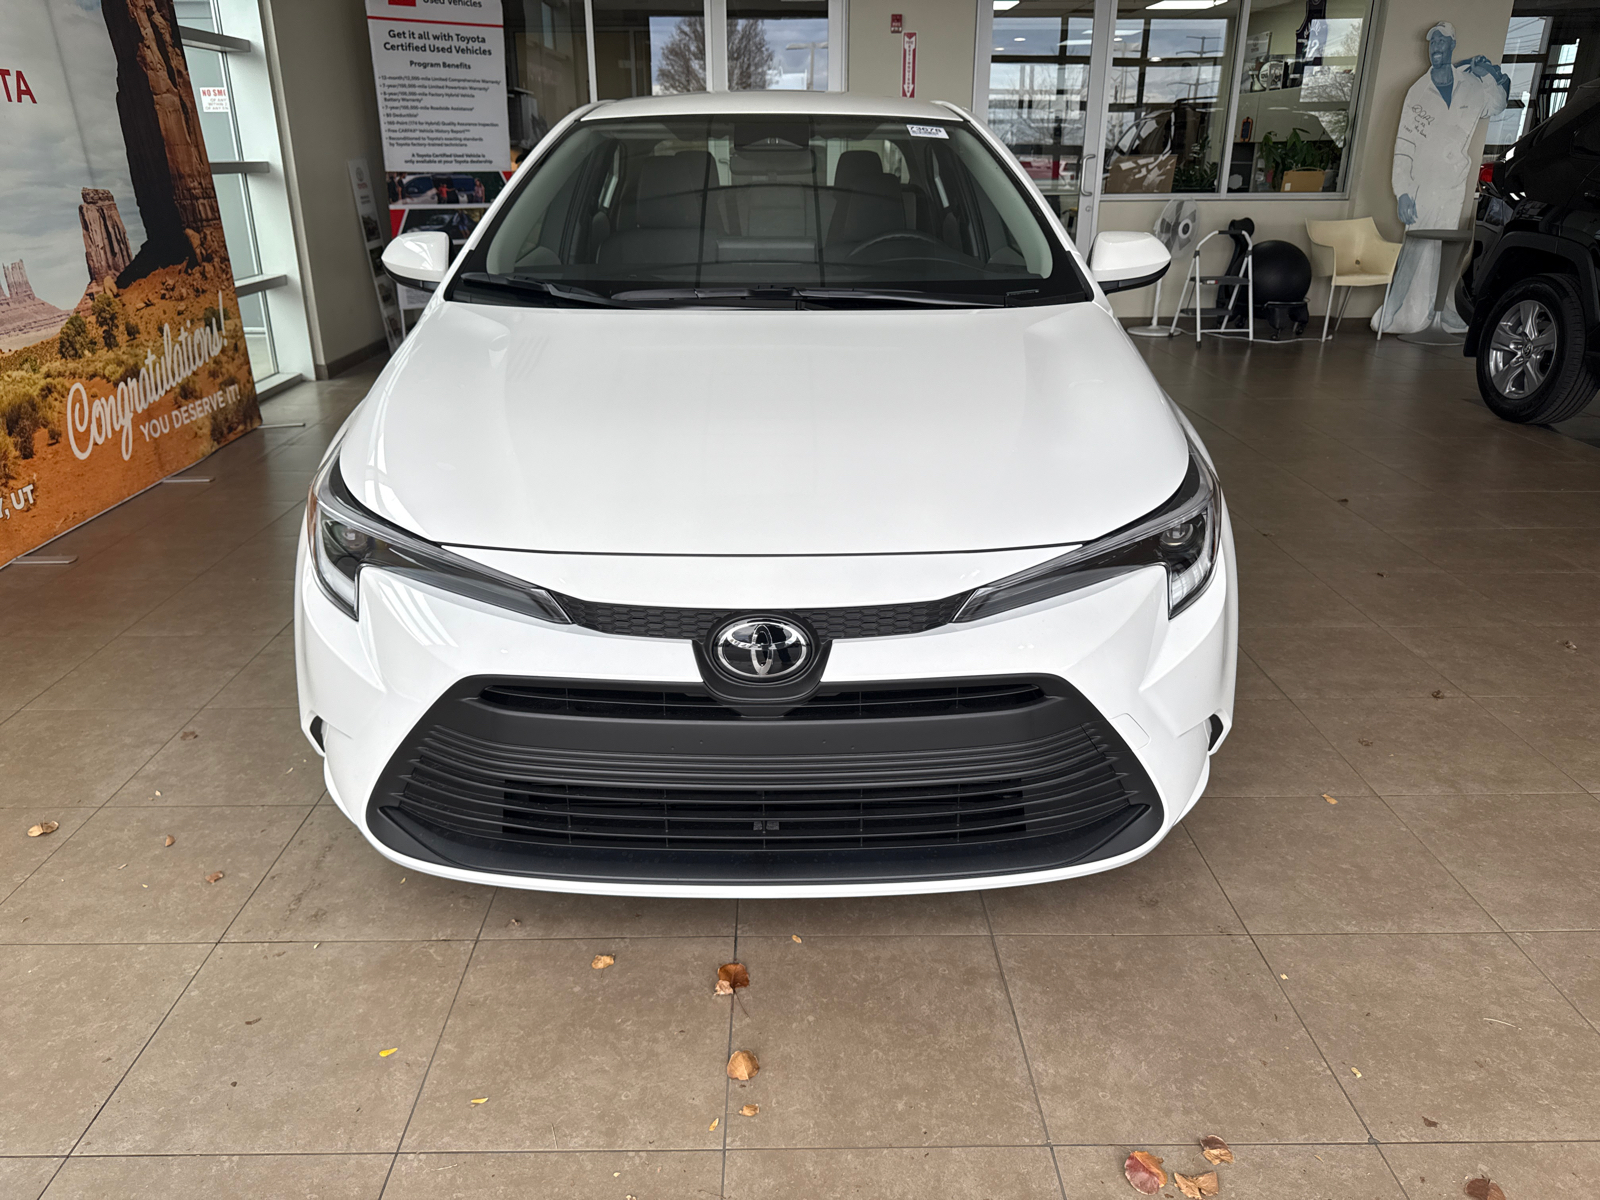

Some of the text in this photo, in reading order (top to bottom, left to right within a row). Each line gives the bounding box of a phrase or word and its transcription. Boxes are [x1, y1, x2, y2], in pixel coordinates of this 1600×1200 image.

[388, 29, 486, 44] Get it all with Toyota
[383, 41, 492, 56] Certified Used Vehicles
[409, 60, 472, 70] Program Benefits
[202, 89, 211, 97] NO
[67, 290, 227, 461] Congratulations!
[140, 383, 241, 442] YOU DESERVE IT!
[10, 483, 34, 510] UT
